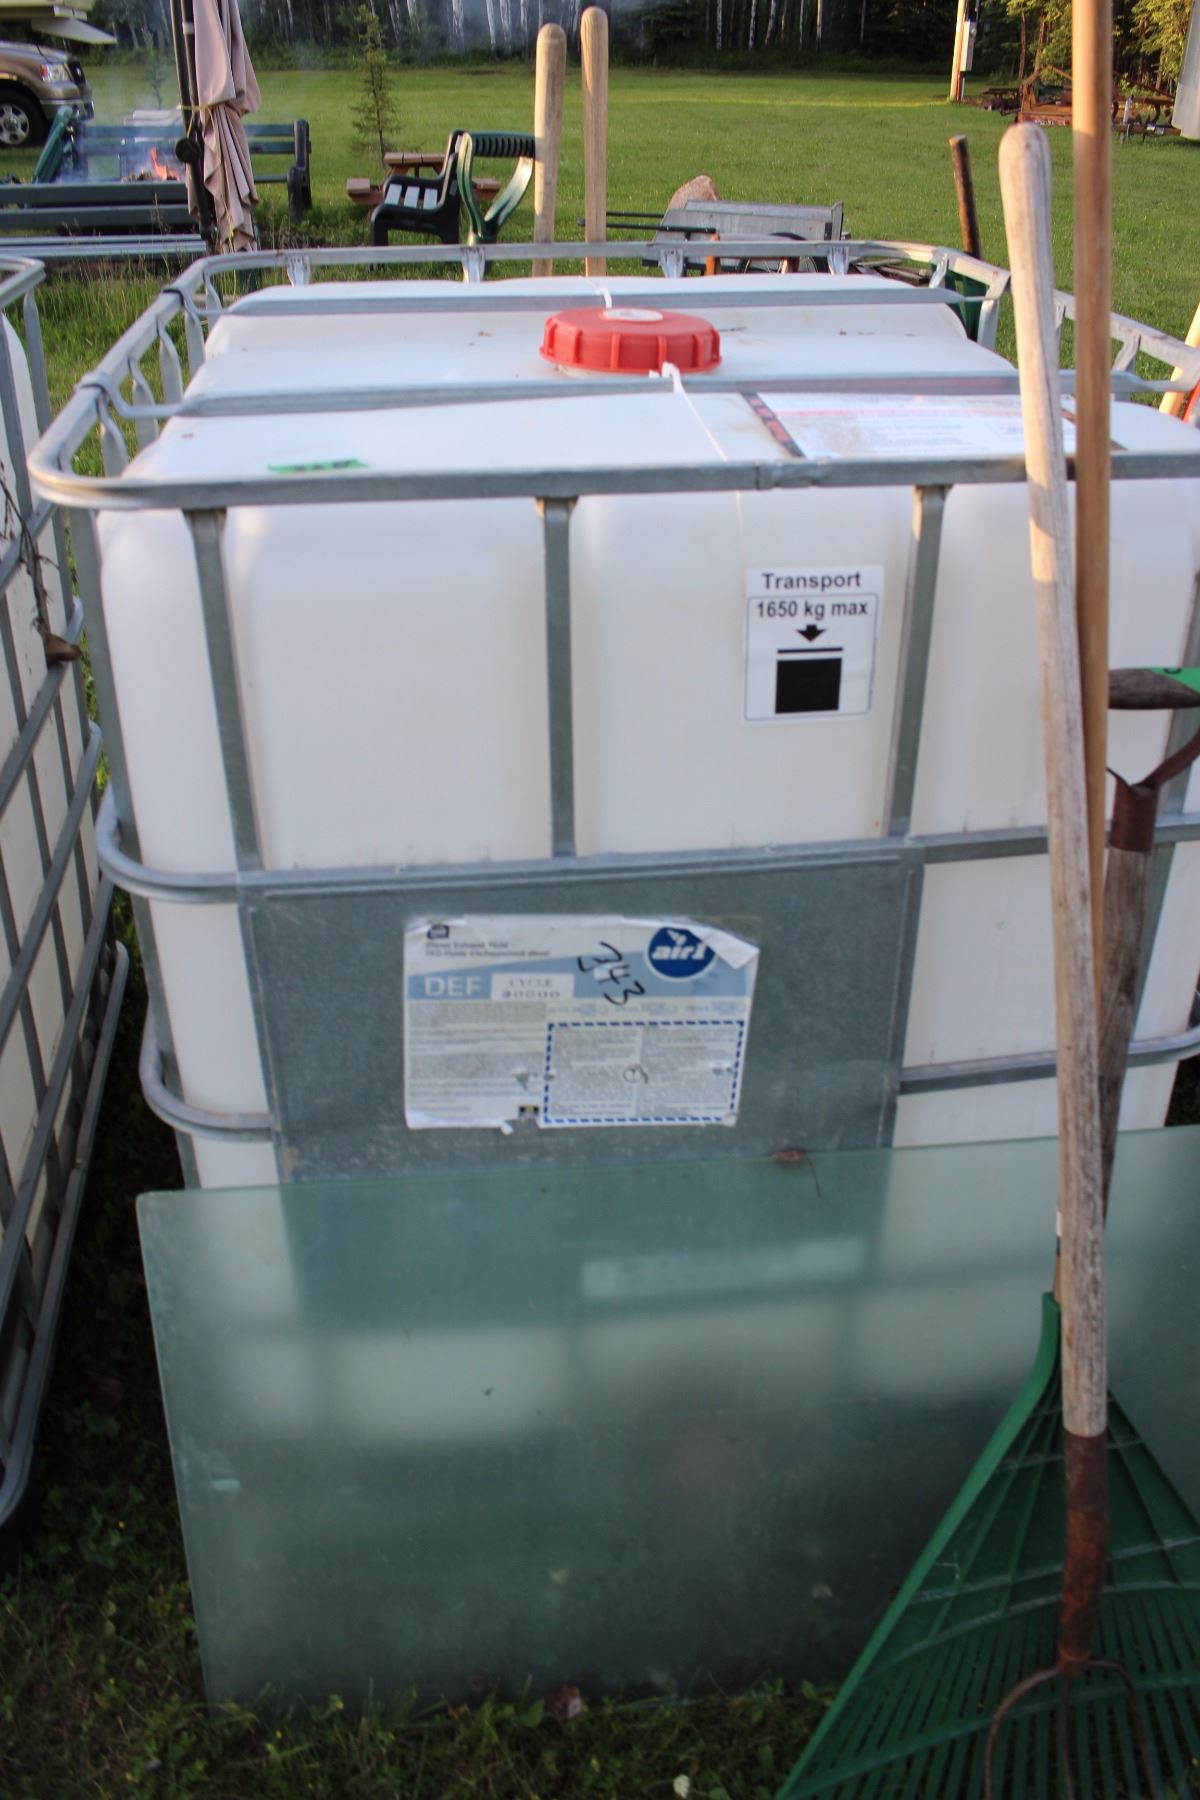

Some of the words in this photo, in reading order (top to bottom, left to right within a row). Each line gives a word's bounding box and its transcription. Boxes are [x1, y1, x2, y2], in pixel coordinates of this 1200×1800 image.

[762, 571, 862, 592] Transport
[757, 600, 798, 619] 1650
[804, 600, 825, 621] kg
[831, 601, 869, 617] max
[424, 976, 482, 997] DEF
